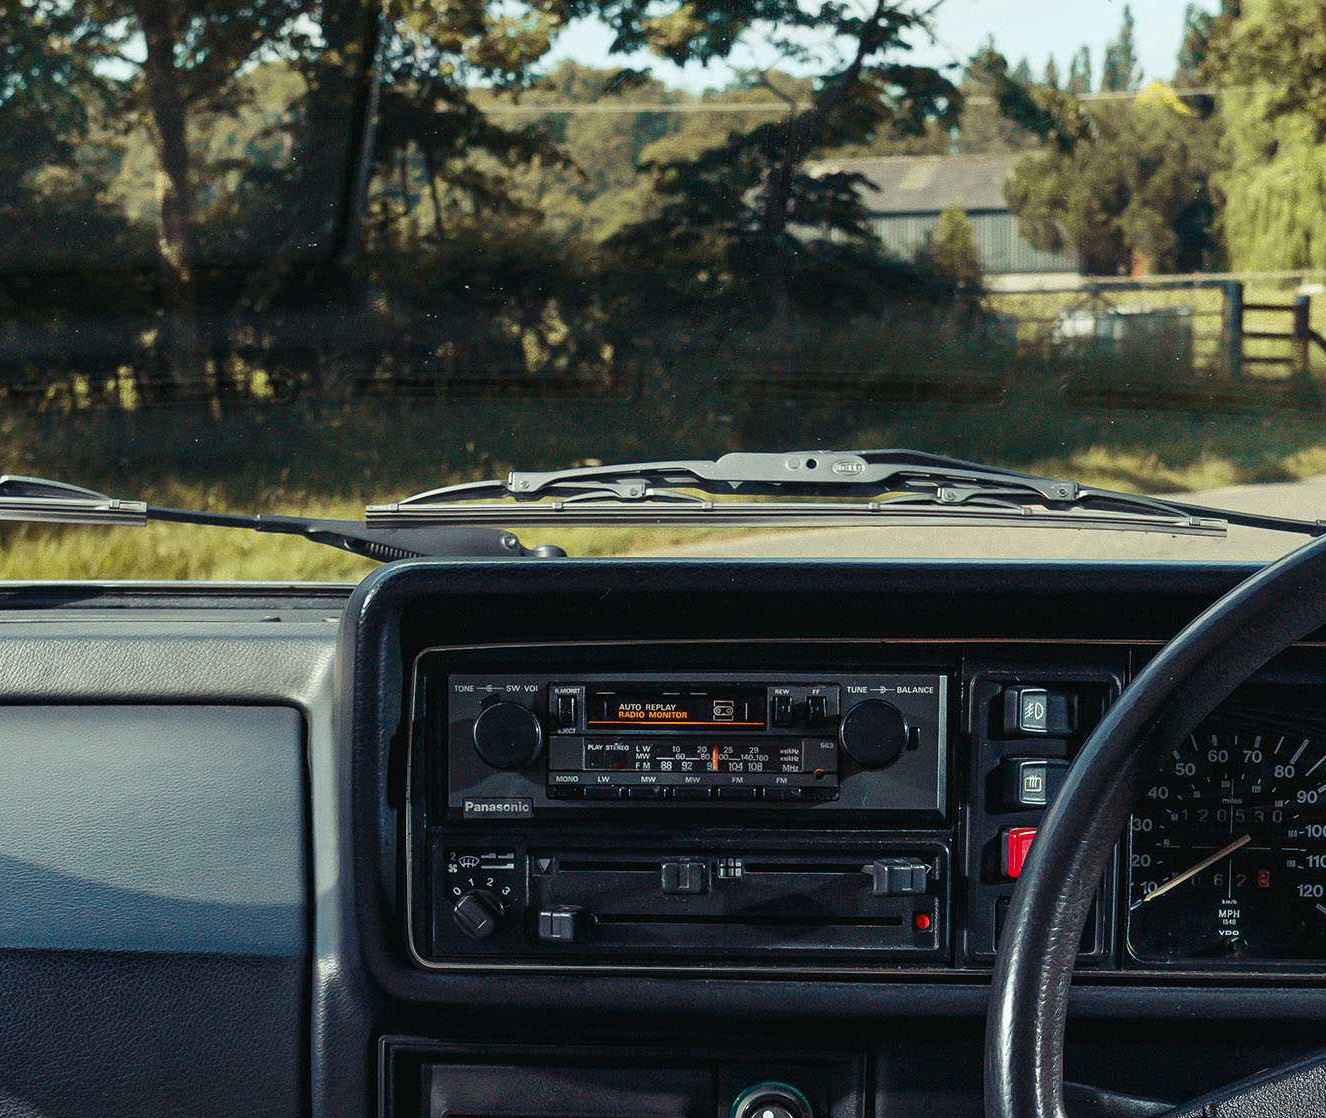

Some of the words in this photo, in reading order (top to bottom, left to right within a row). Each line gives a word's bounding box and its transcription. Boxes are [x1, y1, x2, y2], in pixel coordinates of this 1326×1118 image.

[454, 685, 475, 693] TONE
[847, 686, 868, 694] TUNE
[896, 686, 934, 694] BALANCE
[619, 703, 642, 711] AUTO
[618, 711, 645, 719] RADIO
[648, 711, 688, 719] MONITOR
[1207, 749, 1229, 763] 60
[1243, 750, 1263, 764] 70
[660, 761, 673, 770] 88
[681, 761, 693, 770] 92
[728, 762, 743, 771] 104
[748, 762, 763, 771] 108
[782, 764, 799, 772] MHz
[1174, 762, 1196, 776] 50
[1274, 765, 1295, 779] 80
[1147, 786, 1169, 800] 40
[1296, 790, 1318, 804] 90
[465, 801, 530, 813] Panasonic
[1222, 797, 1243, 805] miles
[1132, 818, 1153, 832] 30
[1131, 854, 1151, 868] 20
[453, 887, 461, 895] 0
[468, 878, 474, 886] 1
[486, 877, 493, 886] 2
[502, 886, 510, 895] 3
[1140, 881, 1159, 895] 10
[1297, 884, 1324, 898] 120
[1221, 898, 1238, 906] km/h
[1218, 909, 1240, 919] MPH
